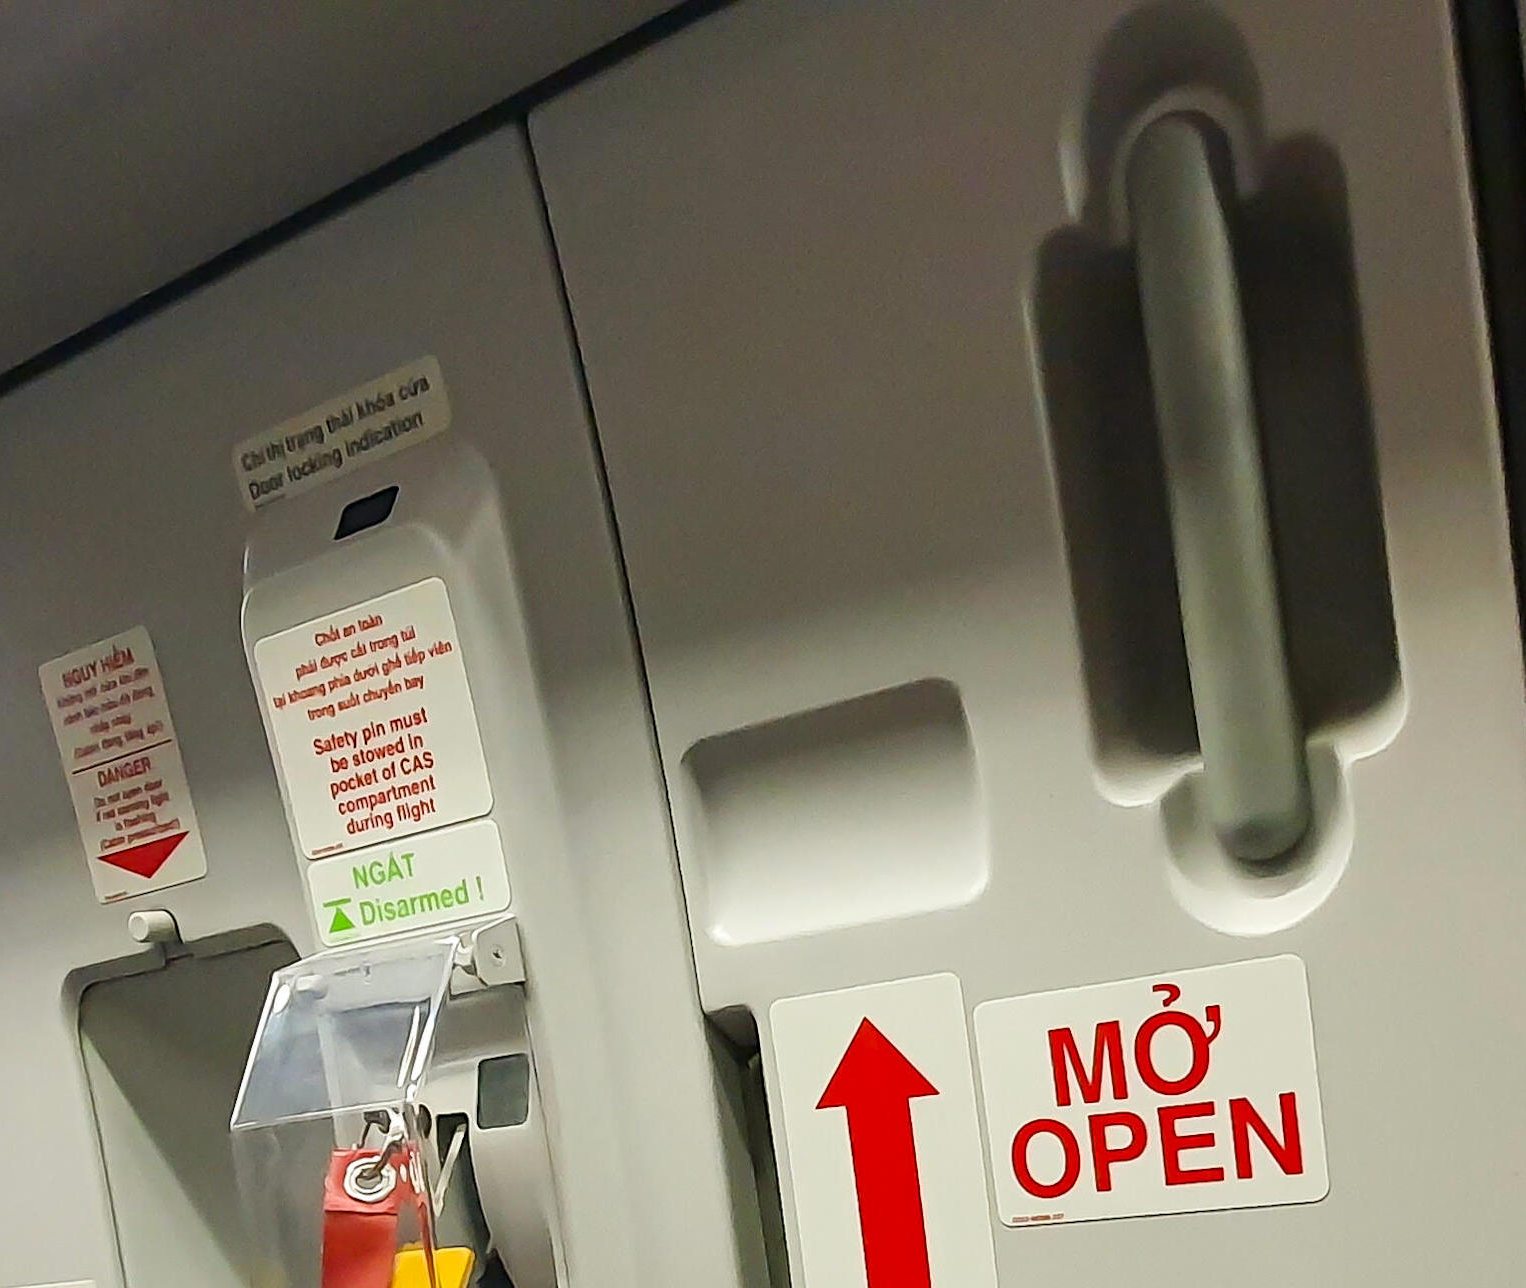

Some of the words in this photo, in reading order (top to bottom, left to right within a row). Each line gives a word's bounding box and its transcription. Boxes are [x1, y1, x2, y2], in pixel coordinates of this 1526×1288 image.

[248, 473, 284, 500] Door
[287, 447, 343, 483] locking
[343, 624, 356, 638] an
[369, 634, 399, 653] trong
[62, 660, 99, 689] NGUY
[307, 704, 336, 721] trong
[404, 674, 424, 692] bay
[313, 730, 358, 755] Safety
[362, 721, 386, 746] pin
[389, 707, 428, 732] must
[330, 756, 349, 773] be
[352, 736, 405, 767] stowed
[407, 733, 424, 750] in
[97, 757, 152, 788] DANGER
[330, 768, 379, 800] pocket
[381, 762, 397, 780] of
[399, 751, 435, 776] CAS
[338, 774, 436, 815] compartment
[346, 808, 394, 835] during
[396, 798, 436, 821] flight
[359, 879, 470, 926] Disarmed
[1048, 983, 1221, 1107] MỞ
[1011, 1092, 1304, 1199] OPEN
